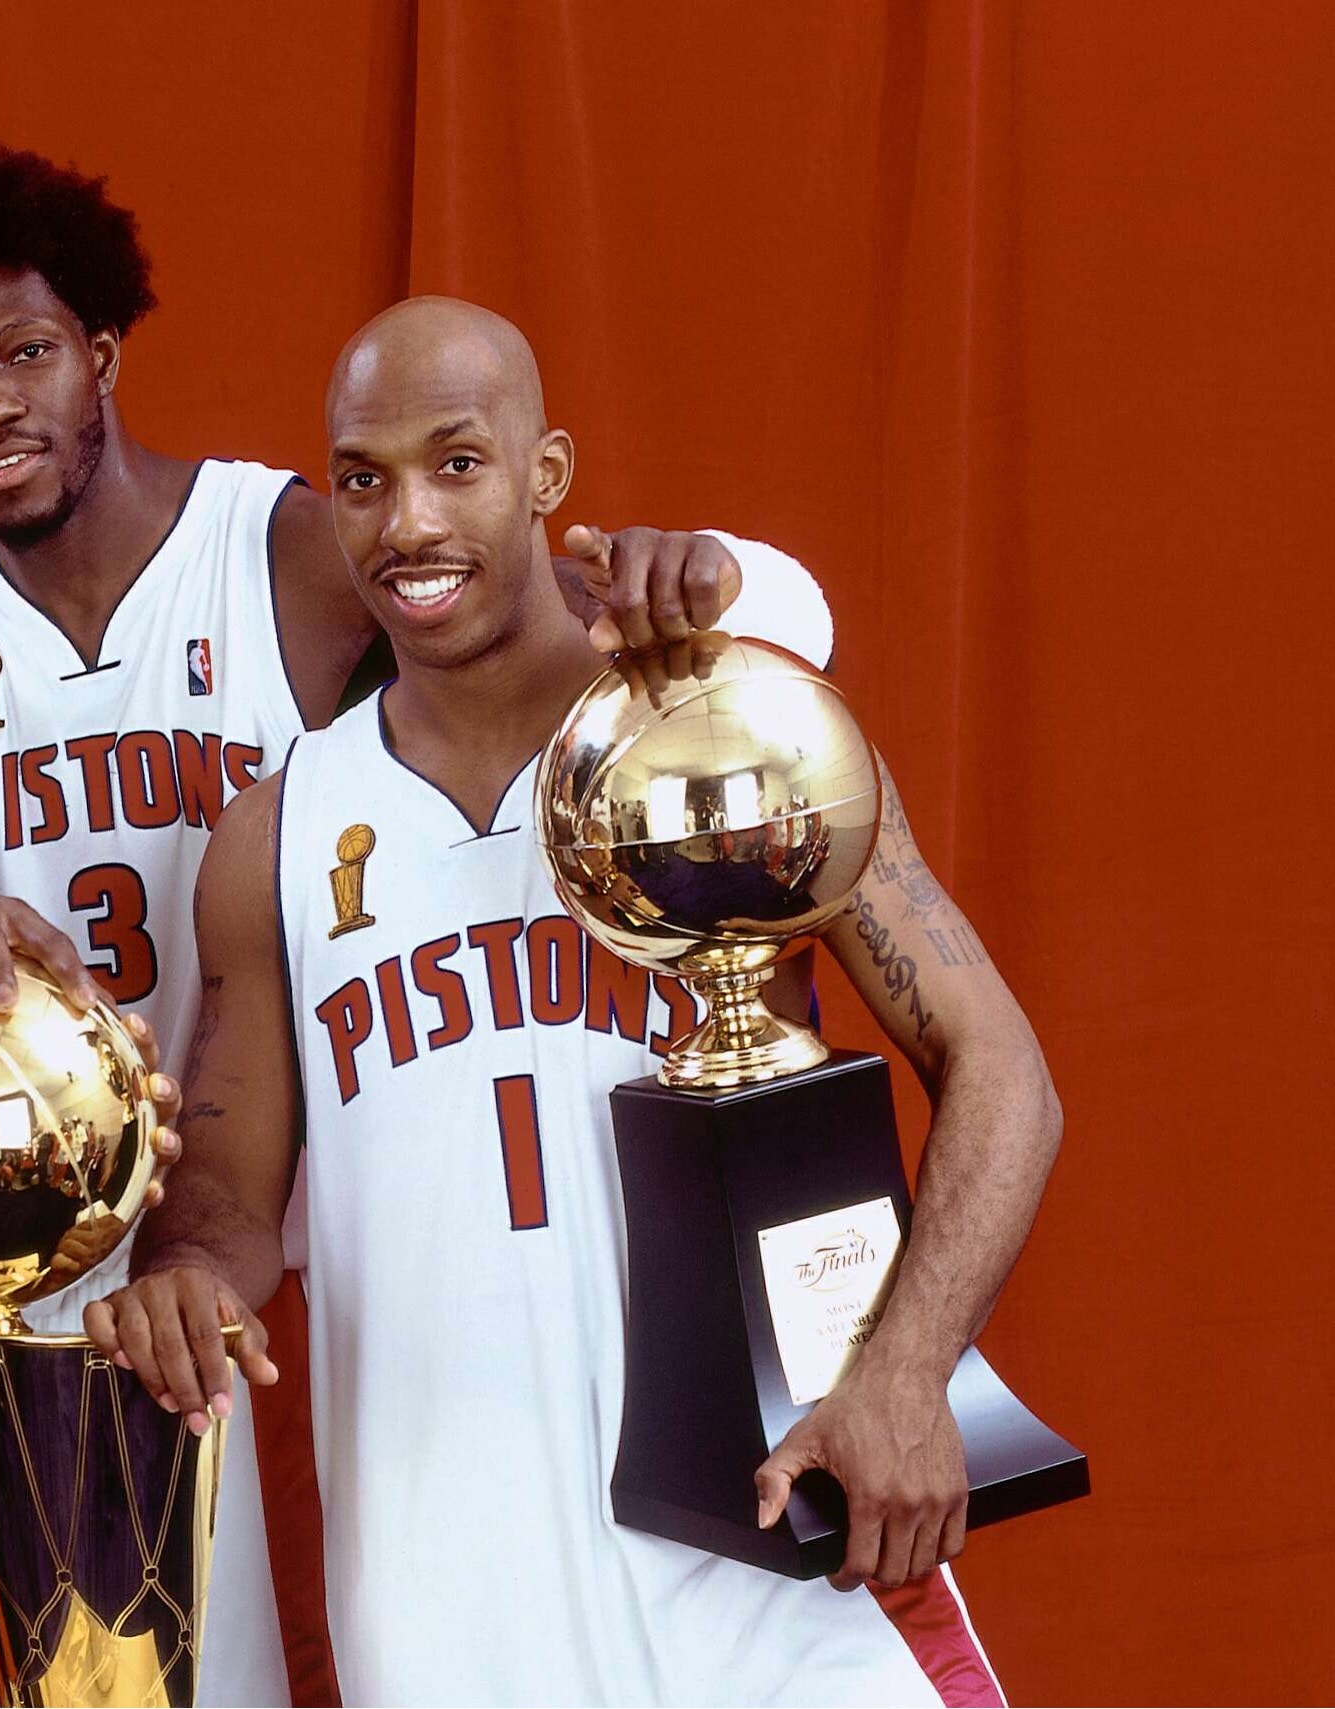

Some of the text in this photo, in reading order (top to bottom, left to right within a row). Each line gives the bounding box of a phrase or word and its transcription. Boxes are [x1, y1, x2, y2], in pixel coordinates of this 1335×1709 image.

[67, 862, 159, 1006] 3
[315, 914, 699, 1107] PISTONS
[492, 1074, 549, 1232] 1
